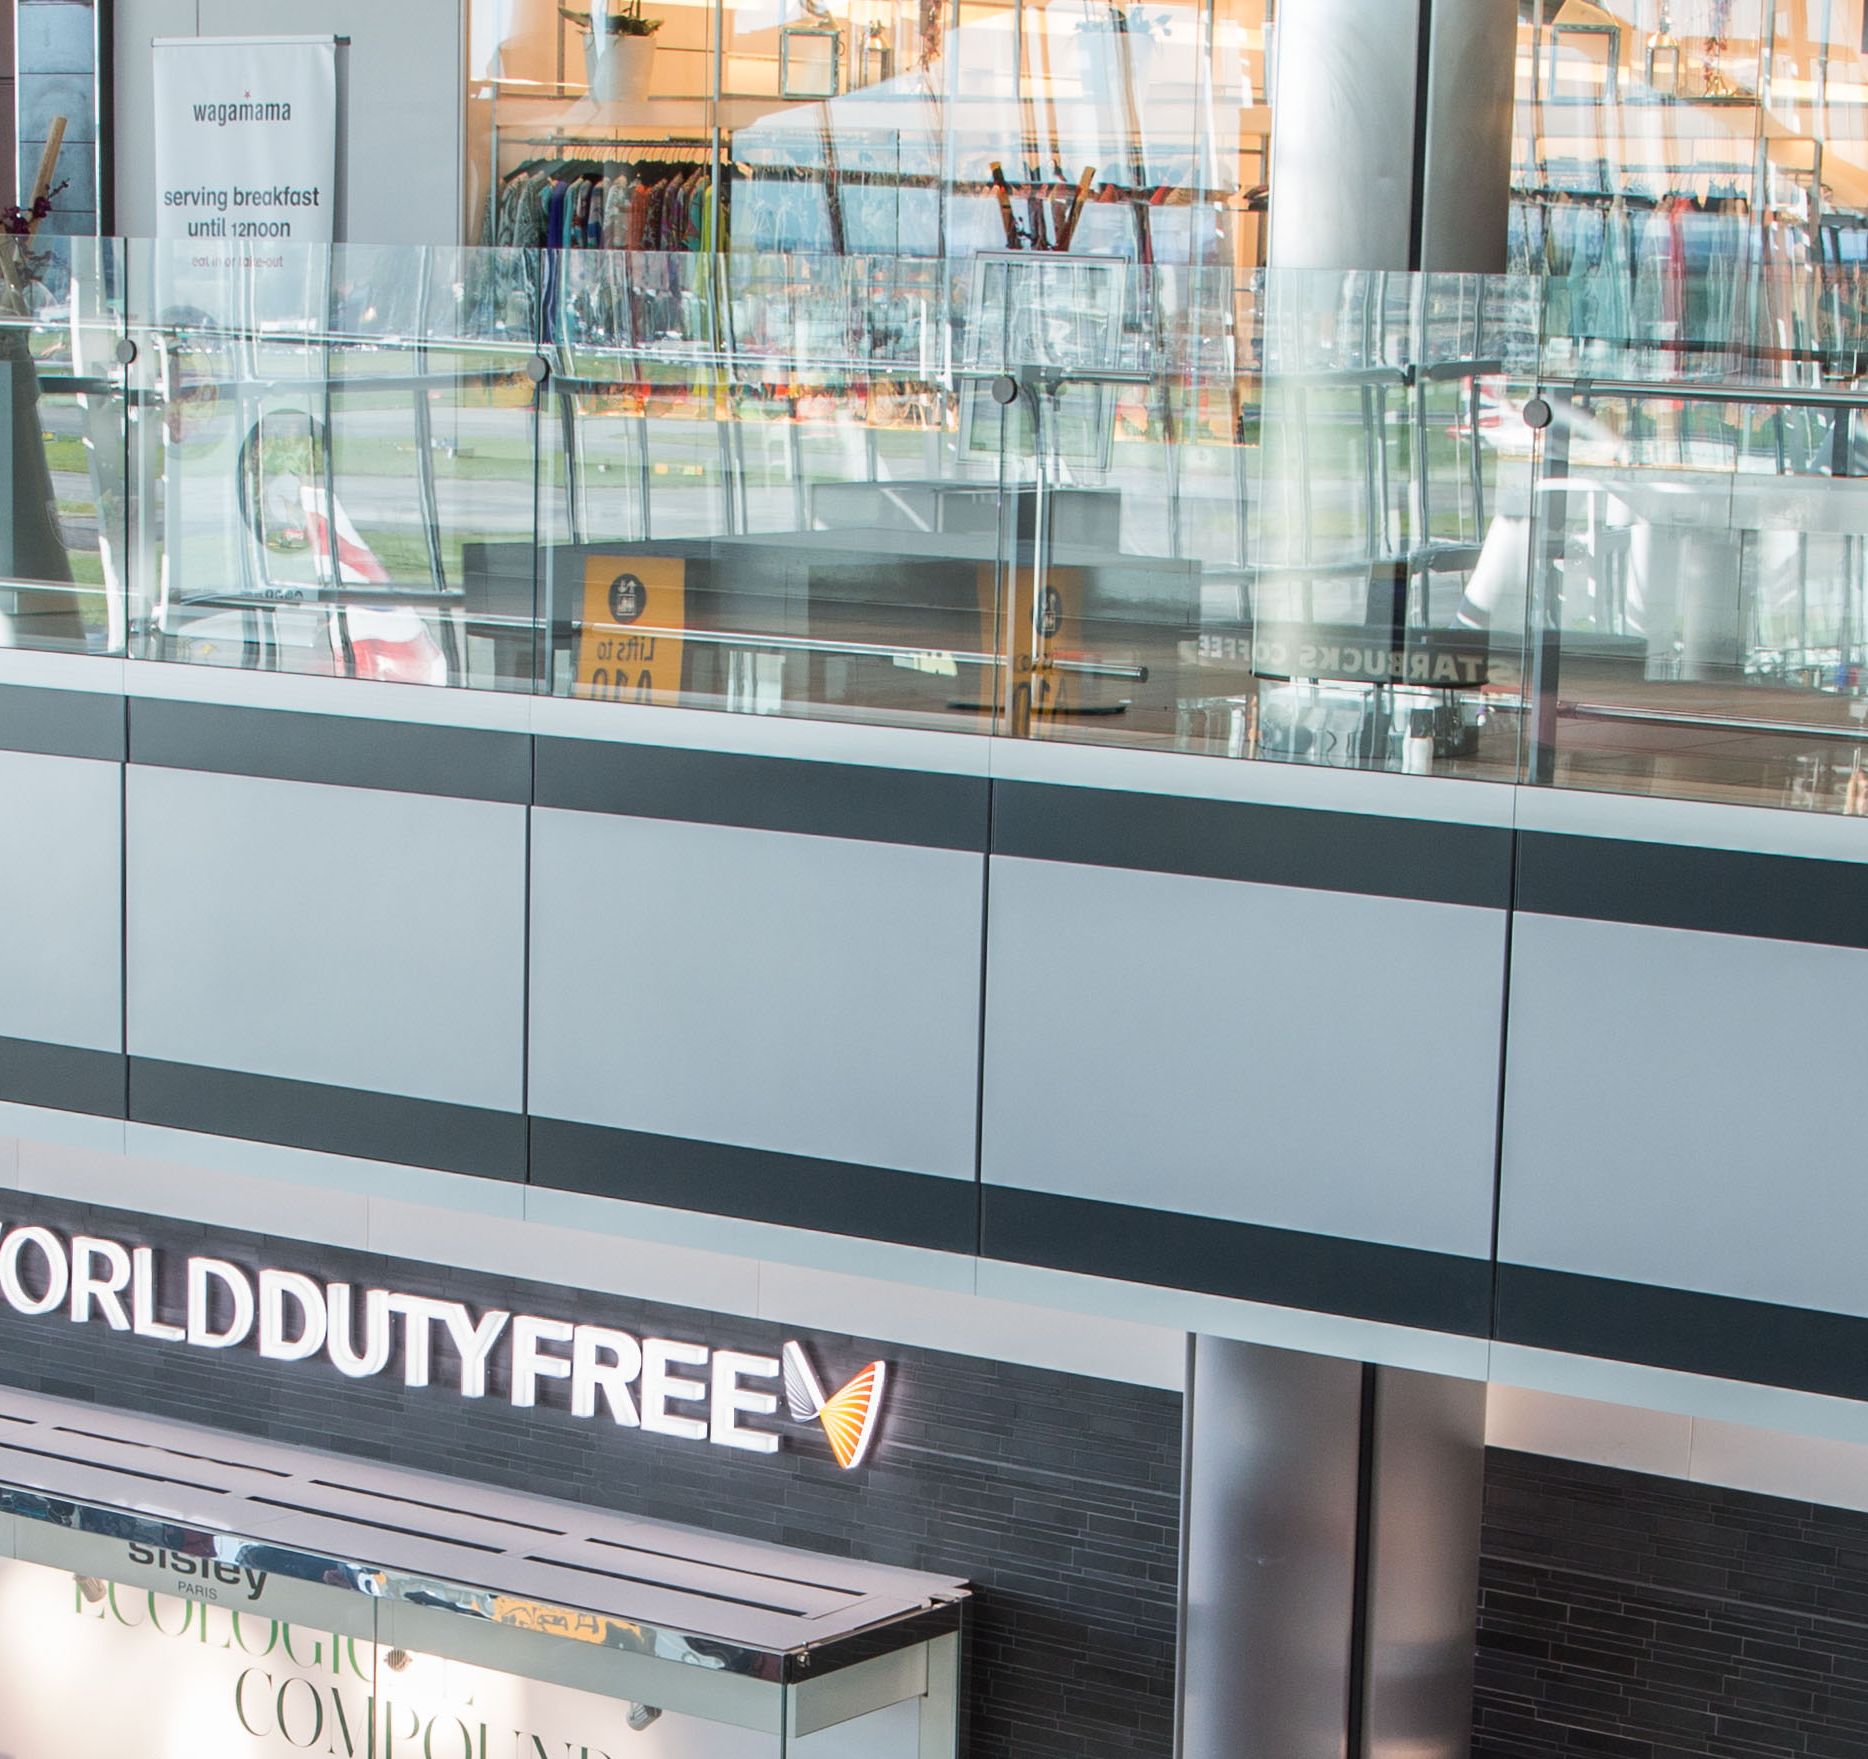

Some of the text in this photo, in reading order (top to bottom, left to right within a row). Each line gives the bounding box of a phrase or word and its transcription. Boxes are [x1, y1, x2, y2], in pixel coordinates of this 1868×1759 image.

[193, 102, 291, 126] wagamama
[164, 186, 320, 212] serving breakfast
[188, 218, 291, 238] until 12noon
[178, 1580, 219, 1601] PARIS
[75, 1576, 474, 1706] ECOLOGIC
